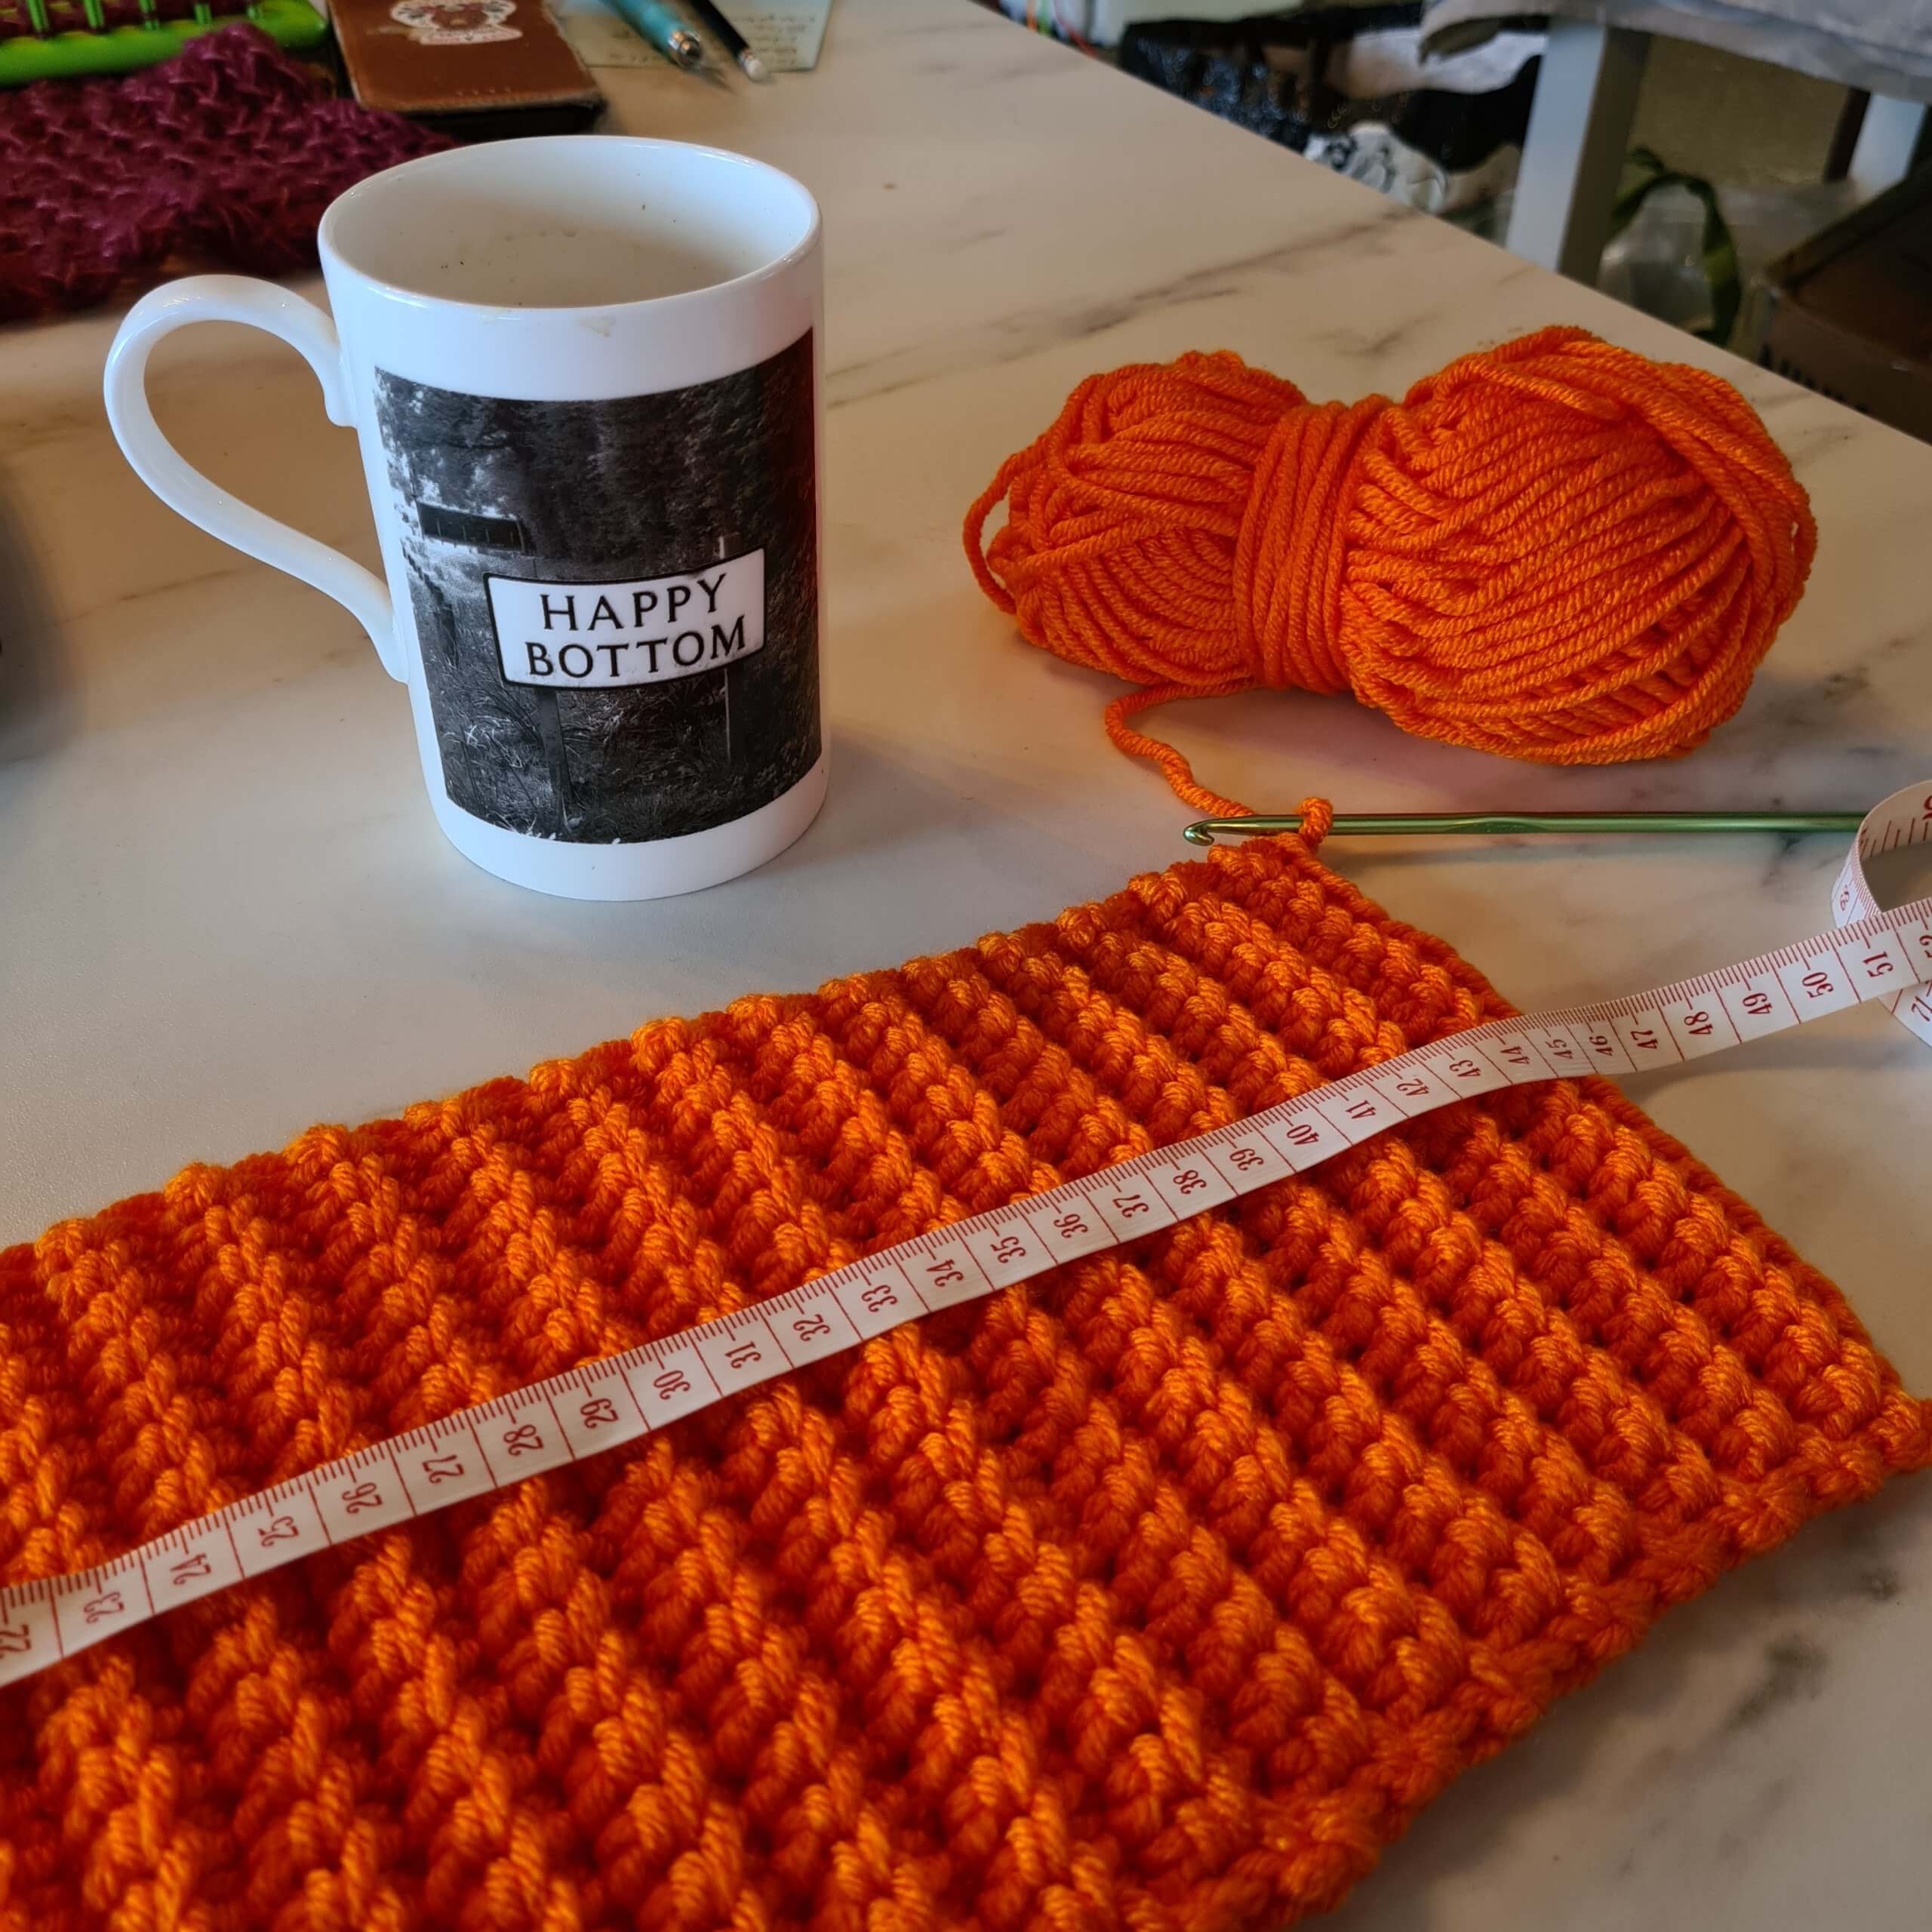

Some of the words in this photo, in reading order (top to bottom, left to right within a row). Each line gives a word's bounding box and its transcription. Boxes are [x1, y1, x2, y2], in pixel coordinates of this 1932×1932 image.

[540, 573, 727, 631] HAPPY
[525, 614, 746, 678] BOTTOM
[1863, 951, 1894, 977] 51
[1801, 971, 1834, 998] 50
[1742, 992, 1772, 1015] 49
[1684, 1011, 1713, 1035] 48
[1545, 1038, 1574, 1060] 45
[1588, 1035, 1614, 1057] 46
[1630, 1030, 1658, 1050] 47
[1449, 1060, 1481, 1078] 43
[1500, 1046, 1530, 1065] 44
[1396, 1078, 1429, 1097] 42
[1345, 1100, 1376, 1119] 41
[1286, 1124, 1319, 1146] 40
[1229, 1148, 1264, 1171] 39
[1173, 1169, 1207, 1195] 38
[1112, 1194, 1149, 1218] 37
[1053, 1214, 1088, 1238] 36
[989, 1236, 1026, 1264] 35
[926, 1259, 964, 1287] 34
[861, 1284, 898, 1313] 33
[792, 1313, 831, 1342] 32
[724, 1341, 761, 1369] 31
[653, 1370, 691, 1401] 30
[580, 1398, 619, 1429] 29
[503, 1424, 544, 1457] 28
[422, 1454, 465, 1484] 27
[341, 1482, 383, 1515] 26
[257, 1515, 300, 1547] 25
[170, 1553, 212, 1586] 24
[82, 1591, 125, 1624] 23
